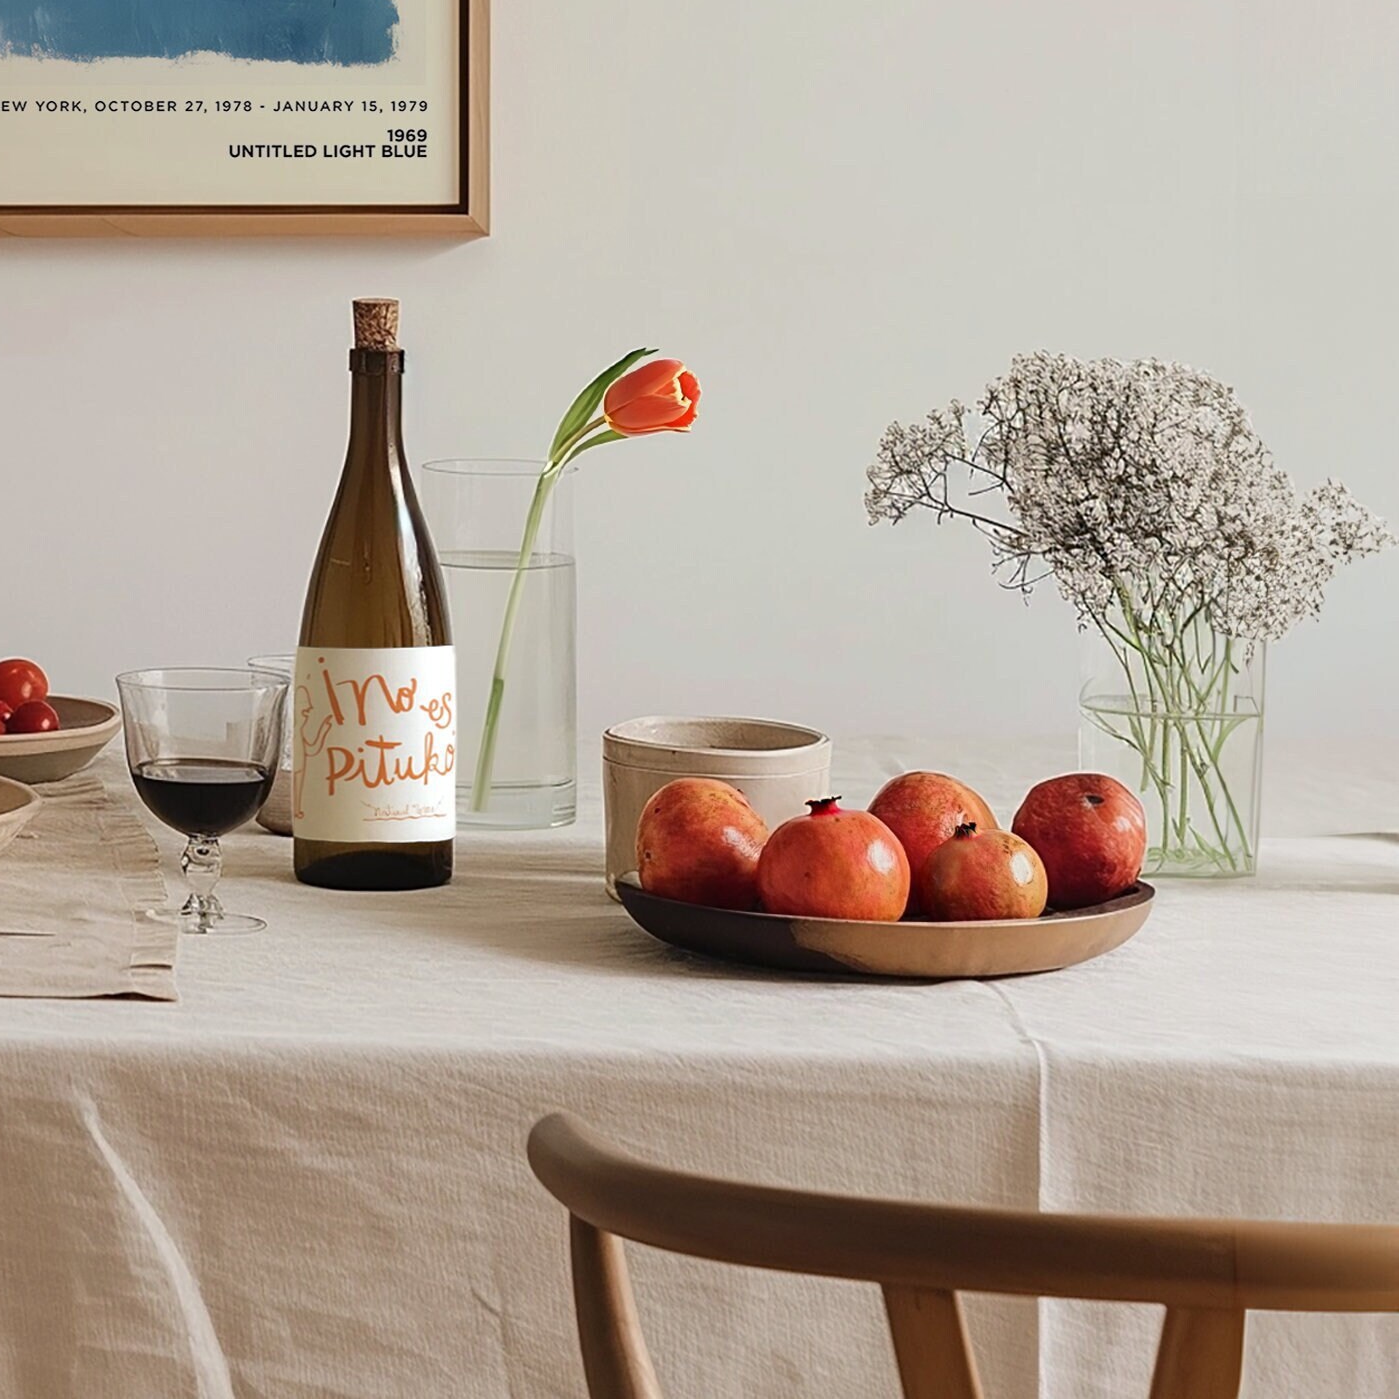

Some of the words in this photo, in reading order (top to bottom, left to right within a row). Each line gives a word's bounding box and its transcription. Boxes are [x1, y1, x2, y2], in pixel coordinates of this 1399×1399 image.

[35, 100, 87, 114] YORK,
[94, 100, 177, 112] OCTOBER
[184, 100, 208, 114] 27,
[215, 100, 252, 112] 1978
[273, 100, 354, 112] JANUARY
[361, 100, 383, 114] 15,
[390, 100, 428, 112] 1979
[386, 128, 428, 143] 1969
[229, 144, 317, 159] UNTITLED
[323, 144, 376, 159] LIGHT
[381, 144, 428, 159] BLUE
